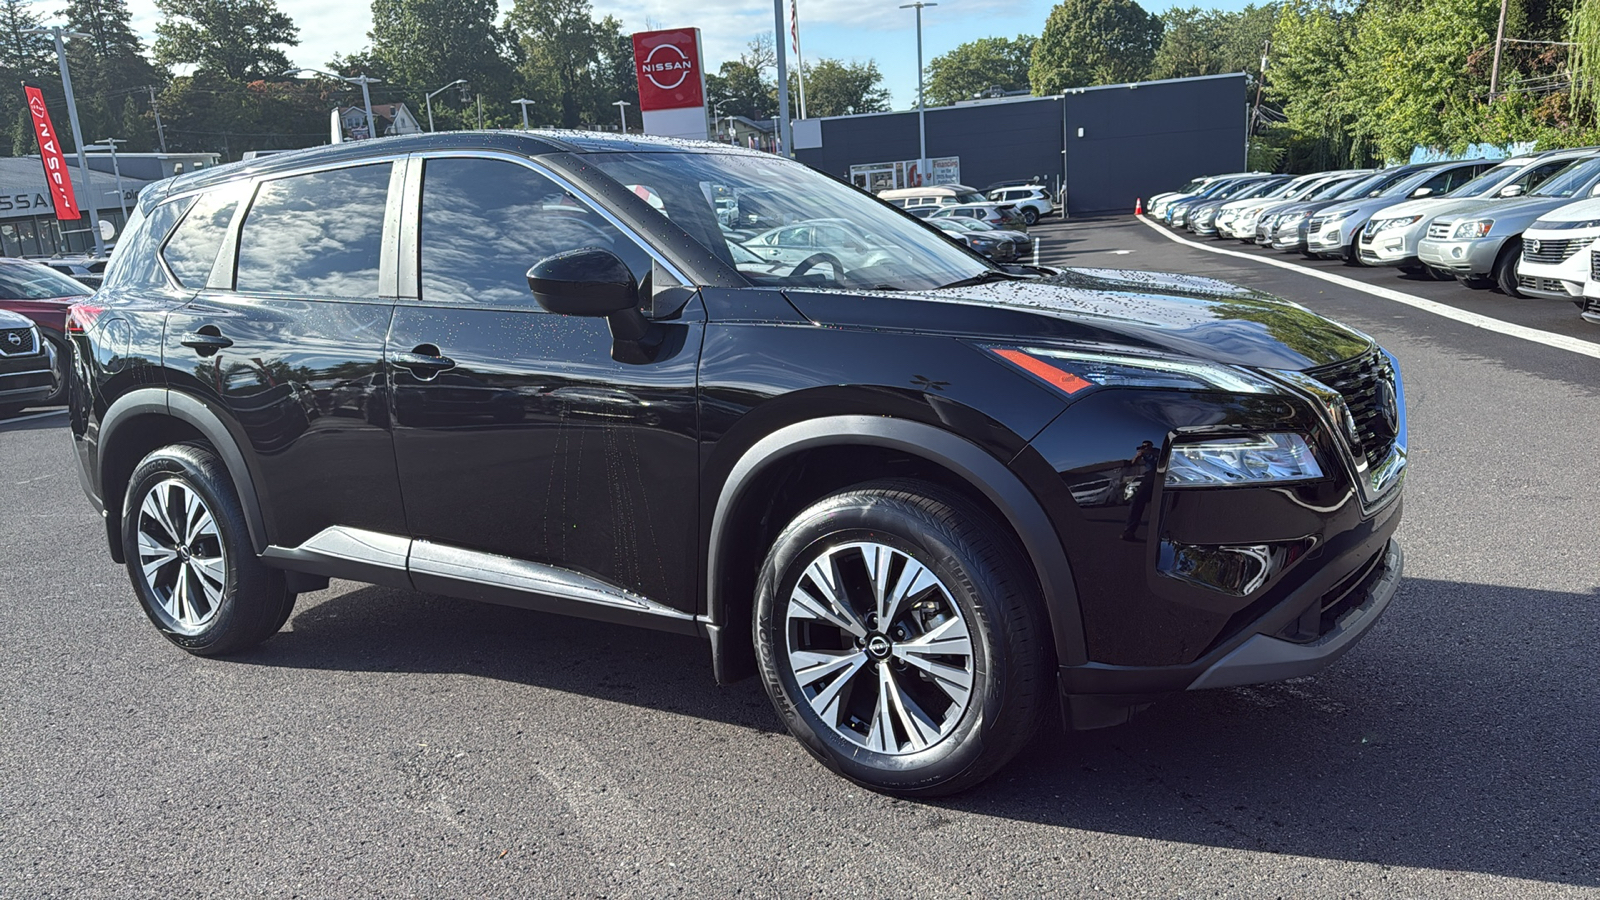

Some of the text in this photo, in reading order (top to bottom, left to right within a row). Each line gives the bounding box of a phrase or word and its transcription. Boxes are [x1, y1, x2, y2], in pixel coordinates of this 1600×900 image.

[642, 60, 692, 73] NISSAN
[39, 123, 71, 208] NISSAN
[0, 193, 54, 211] SSA
